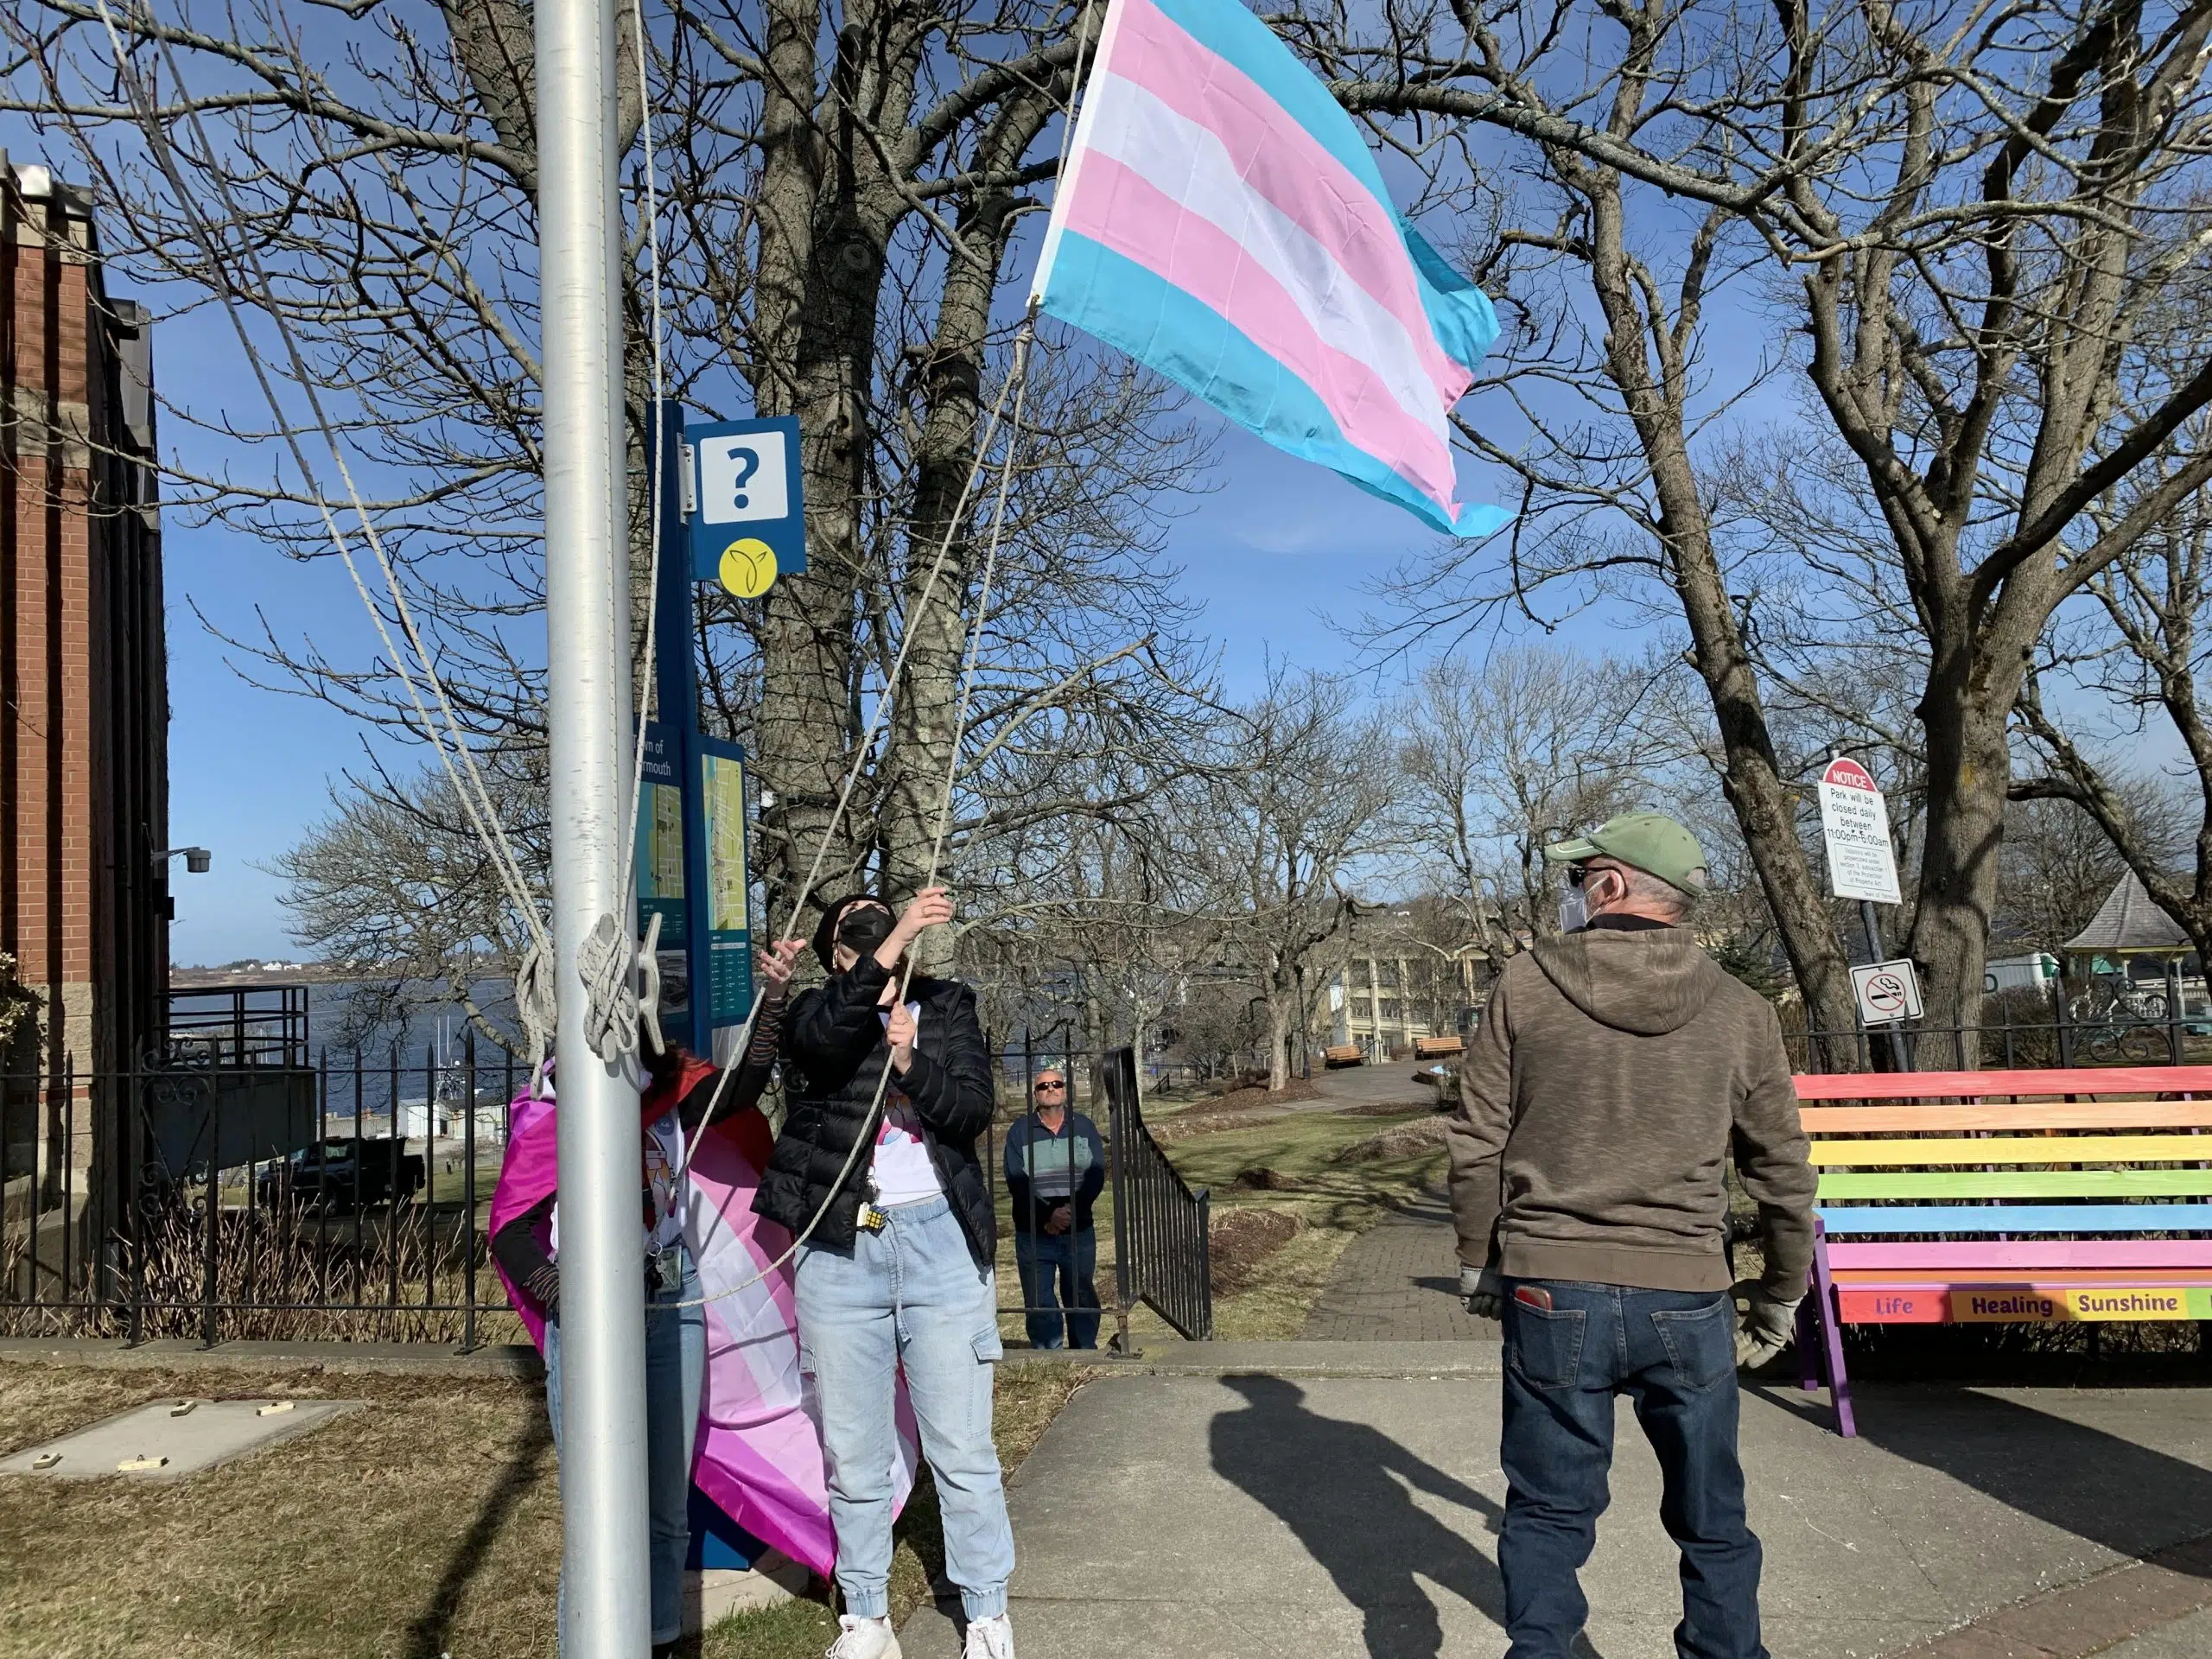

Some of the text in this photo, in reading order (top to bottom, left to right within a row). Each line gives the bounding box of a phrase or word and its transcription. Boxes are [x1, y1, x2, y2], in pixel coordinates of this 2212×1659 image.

[632, 734, 664, 754] Twn of
[642, 760, 671, 777] rmouth
[1832, 770, 1867, 788] NOTICE
[1830, 787, 1874, 805] Park will be
[1832, 803, 1876, 821] closed daily
[1840, 817, 1872, 830] between
[1827, 828, 1889, 847] 11:00pm-6:00am
[1875, 1293, 2178, 1319] Life Healing Sunshine
